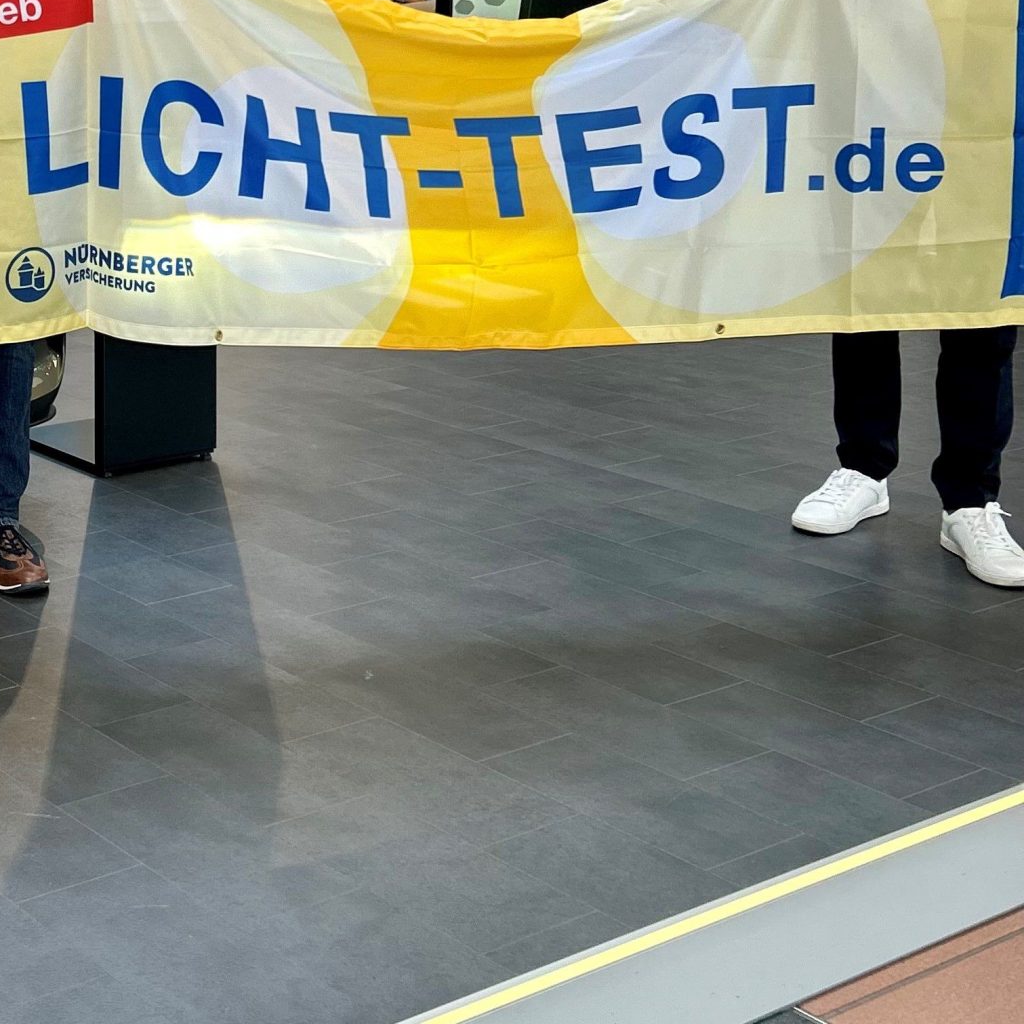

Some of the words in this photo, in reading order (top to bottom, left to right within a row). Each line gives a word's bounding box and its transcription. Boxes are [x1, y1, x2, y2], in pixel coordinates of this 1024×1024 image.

[20, 76, 945, 218] LICHT-TEST.de
[64, 243, 194, 276] NÜRNBERGER
[64, 268, 156, 293] VERSICHERUNG
